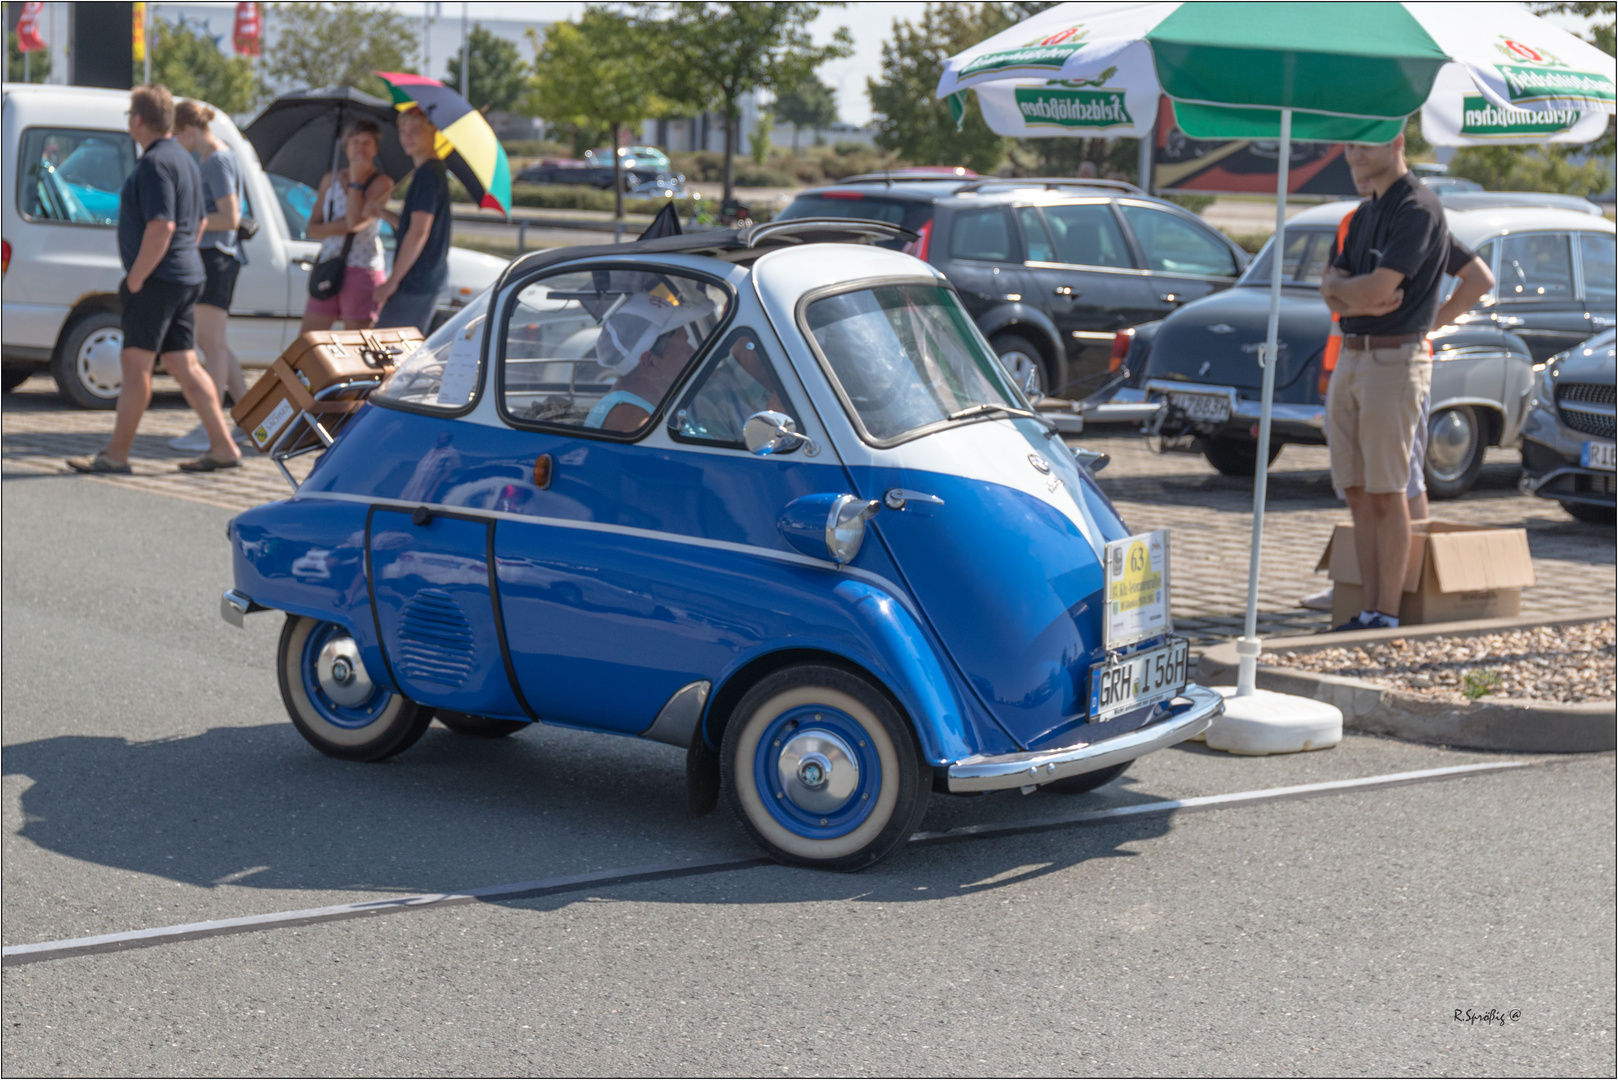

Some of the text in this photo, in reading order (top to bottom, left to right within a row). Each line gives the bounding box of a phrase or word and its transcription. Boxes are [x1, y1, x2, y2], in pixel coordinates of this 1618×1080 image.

[1131, 547, 1144, 572] 63
[1100, 647, 1186, 708] GRH I 56H
